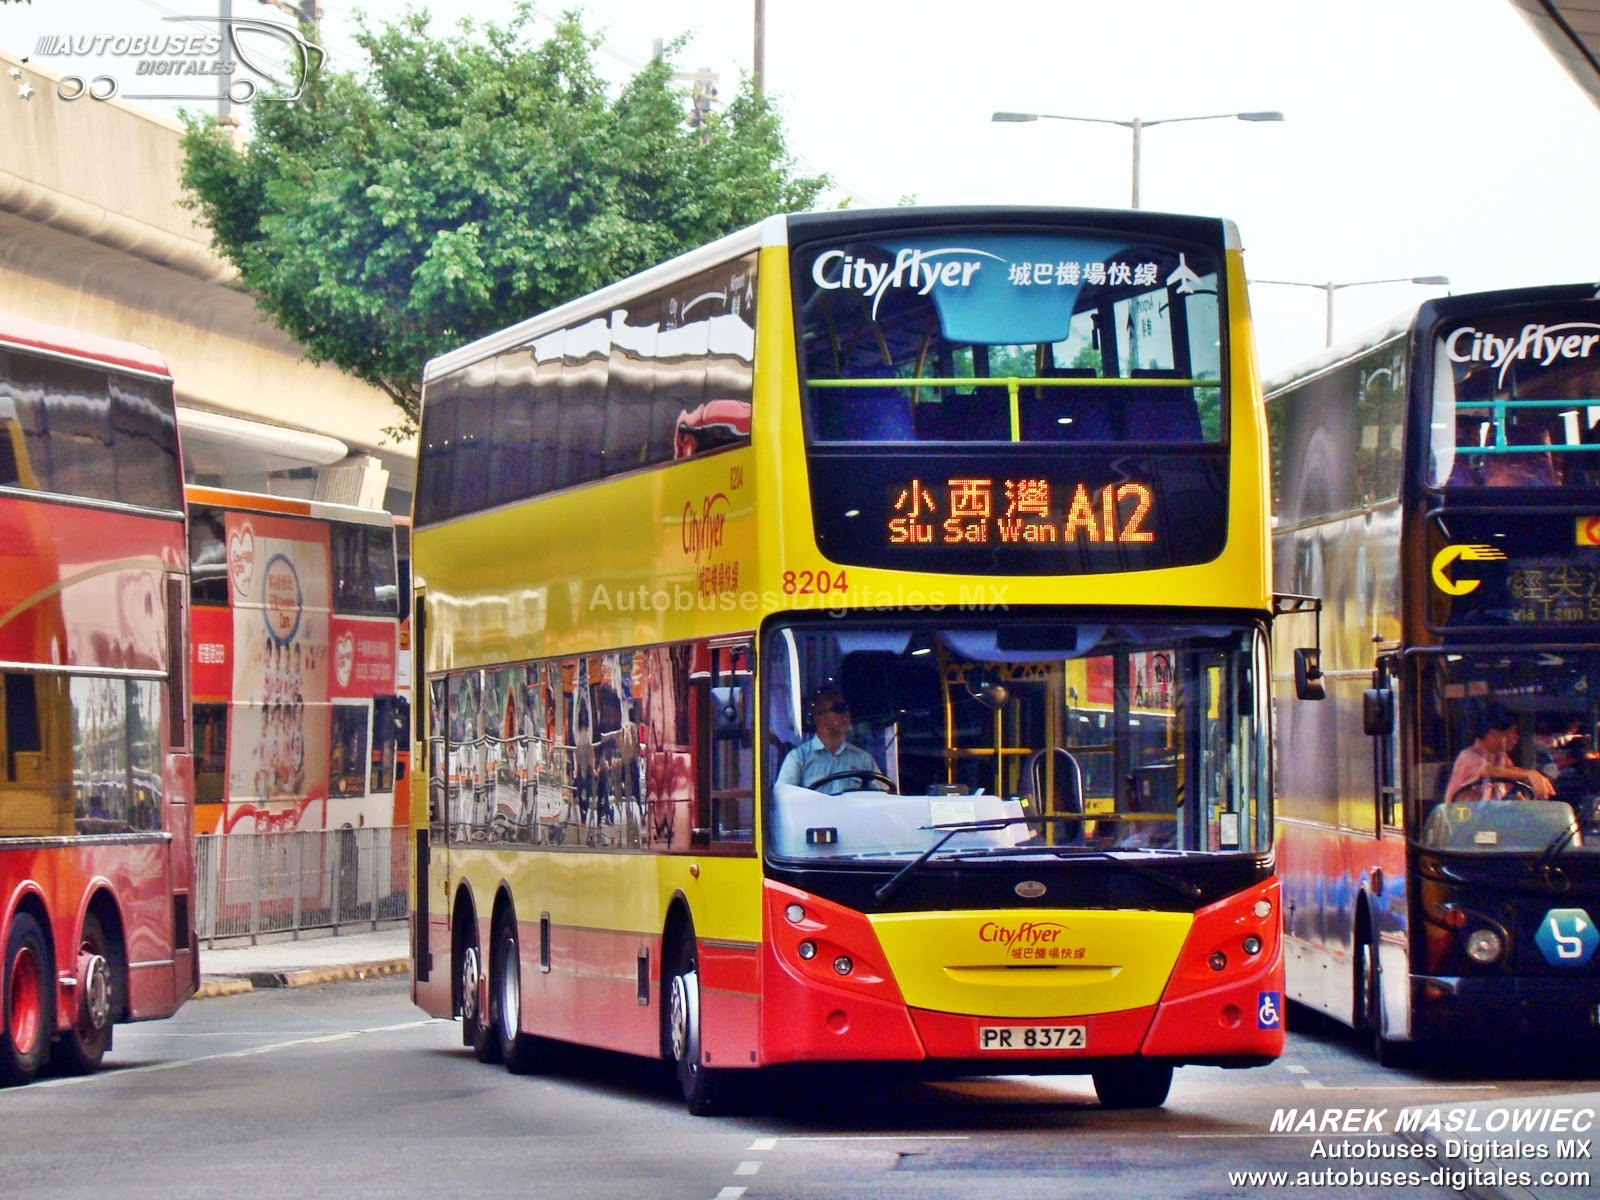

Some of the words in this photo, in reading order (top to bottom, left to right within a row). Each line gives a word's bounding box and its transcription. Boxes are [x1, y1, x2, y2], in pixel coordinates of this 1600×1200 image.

[1008, 262, 1158, 287] 城巴機場快線
[894, 479, 1050, 518] 小西灣
[1064, 483, 1155, 542] A12
[888, 517, 933, 542] Siu
[943, 517, 987, 542] Sai
[997, 517, 1057, 542] Wan
[783, 570, 848, 594] 8204
[1010, 947, 1086, 959] 城巴機場快線
[983, 1029, 1013, 1048] PR
[1024, 1028, 1083, 1047] 8372
